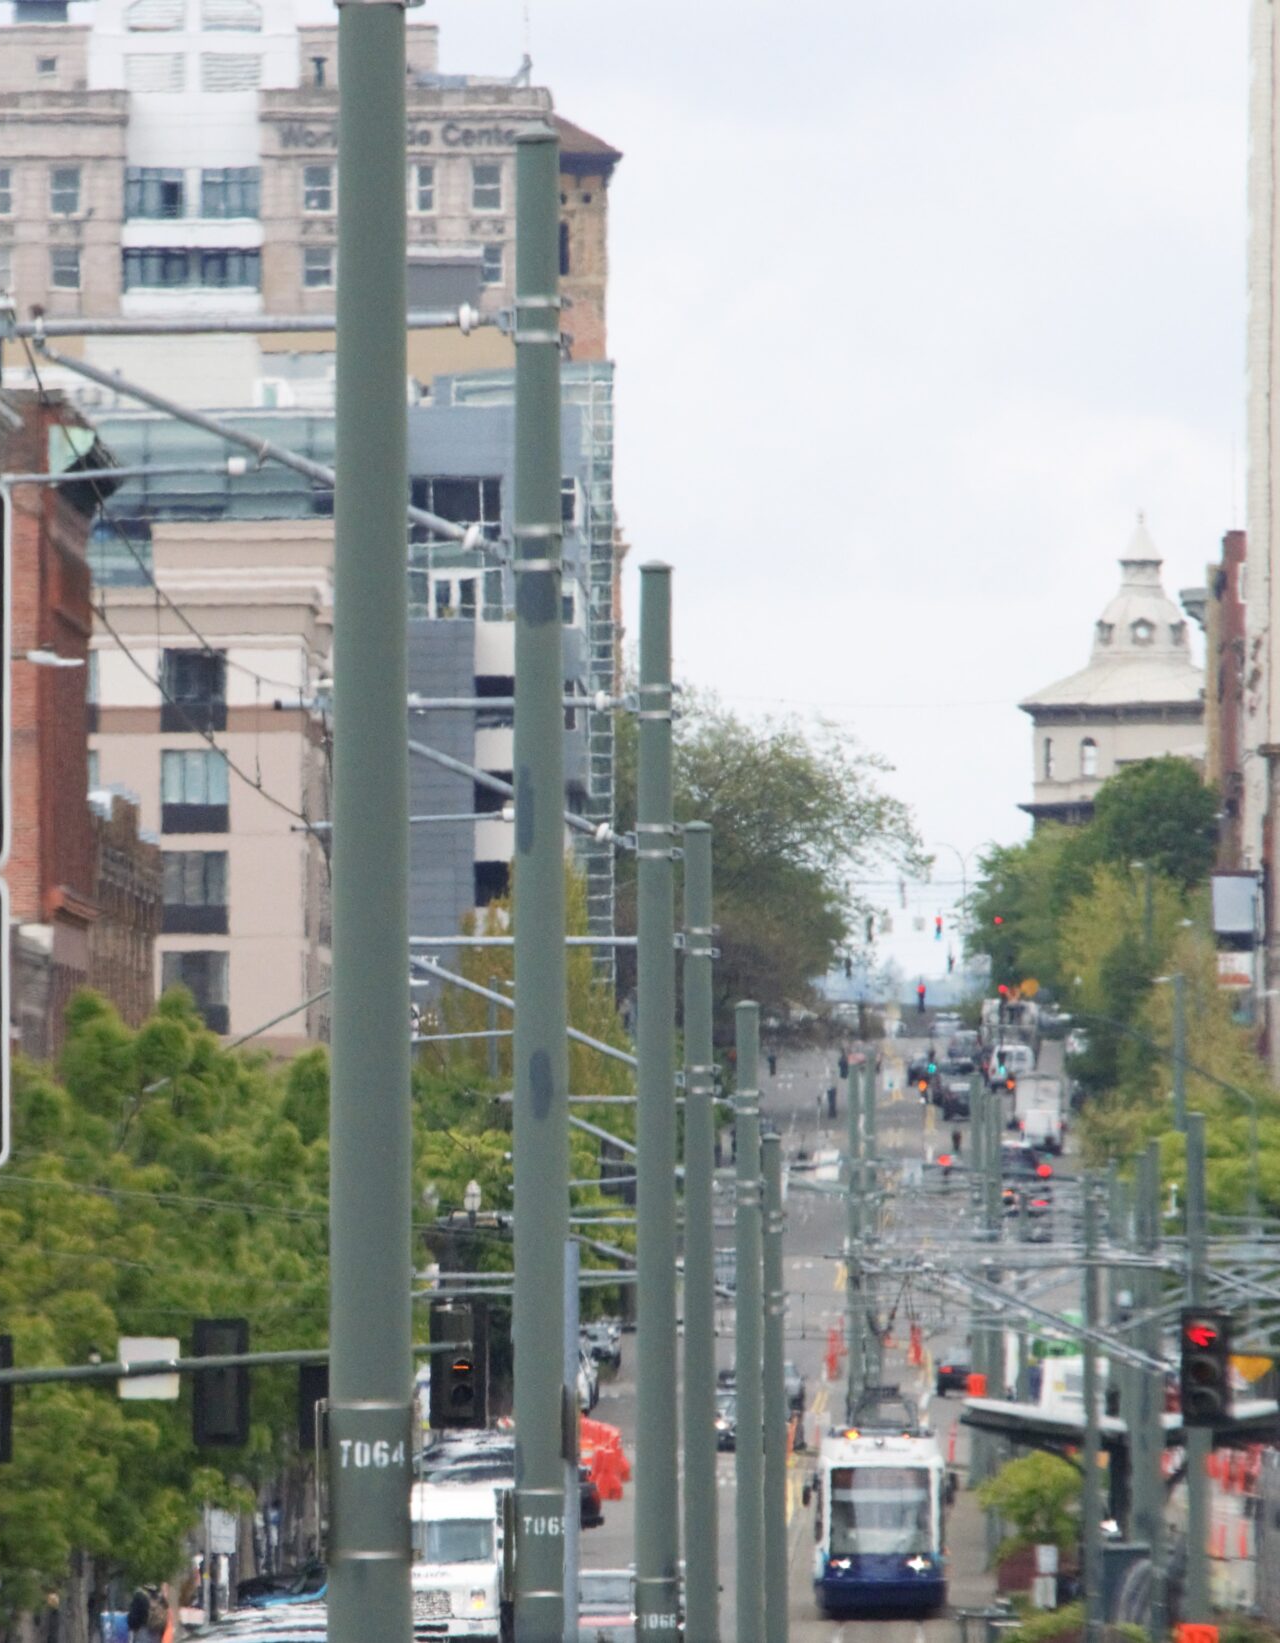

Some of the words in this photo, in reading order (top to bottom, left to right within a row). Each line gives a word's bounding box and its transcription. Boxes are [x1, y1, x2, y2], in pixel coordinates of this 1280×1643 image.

[277, 121, 337, 148] Wor
[441, 121, 516, 147] Cente
[339, 1439, 405, 1468] T064
